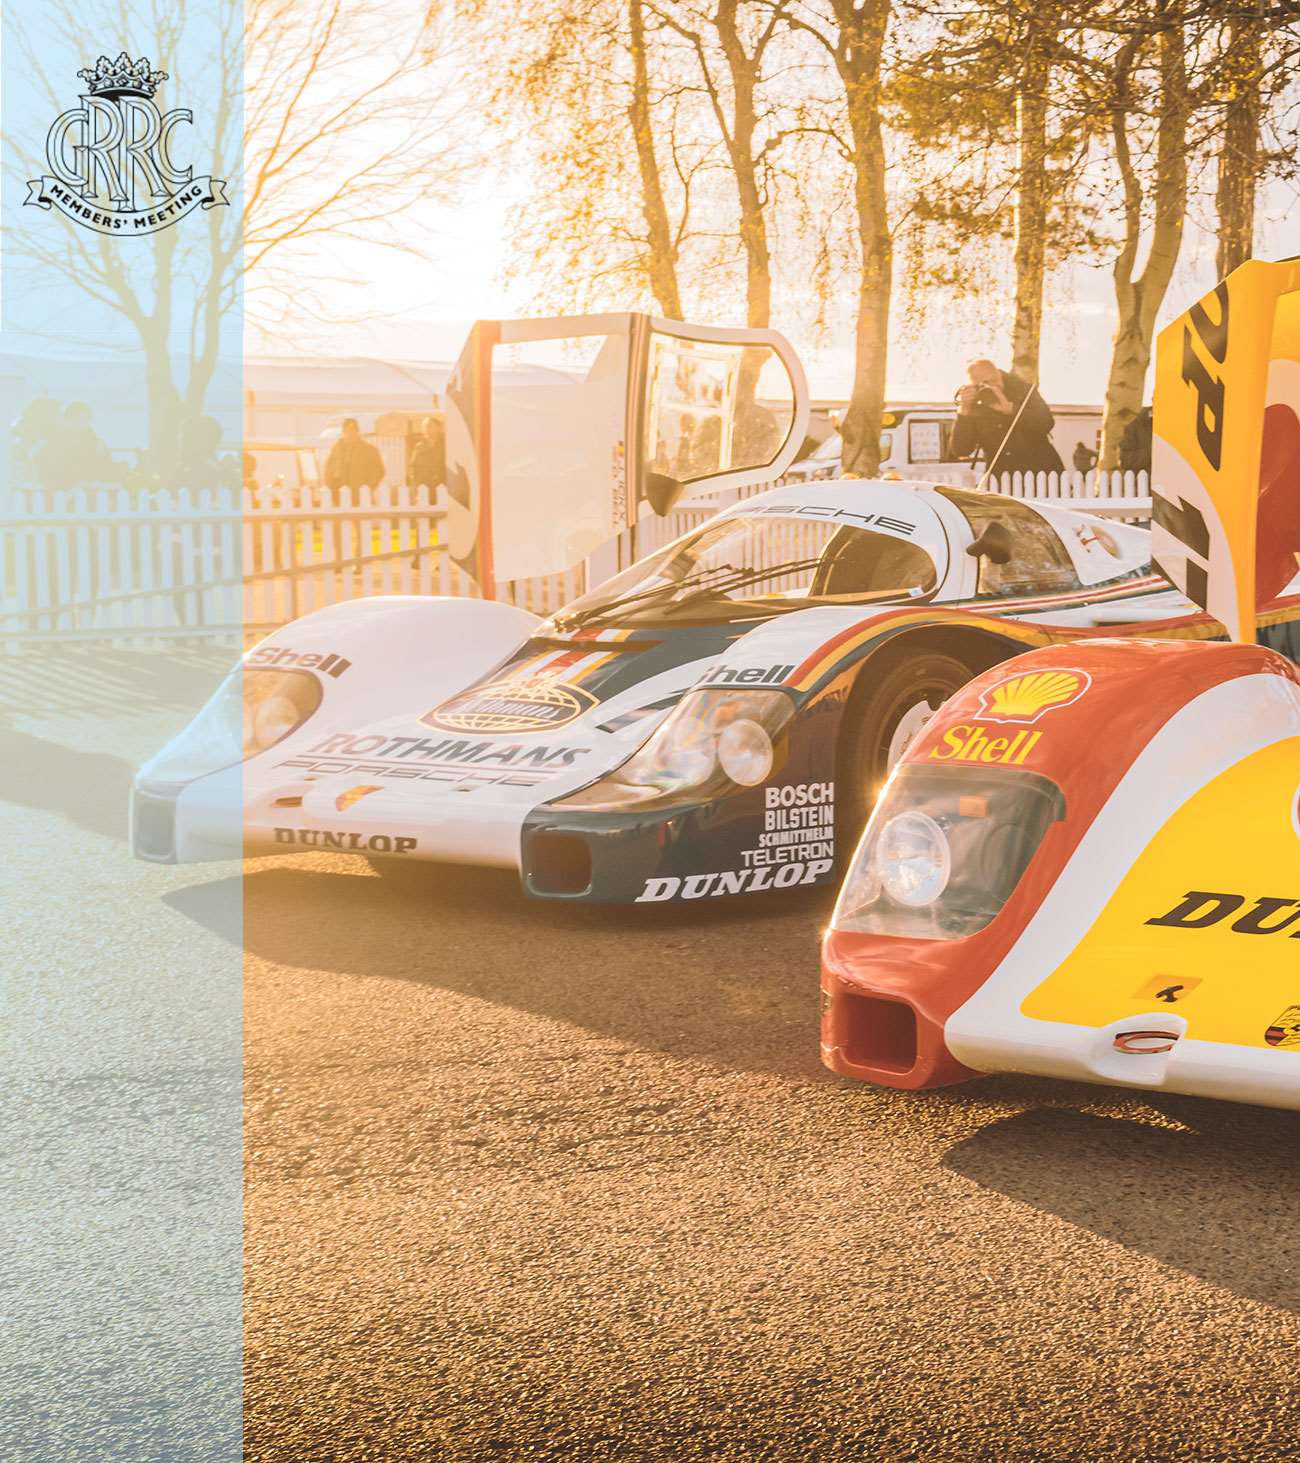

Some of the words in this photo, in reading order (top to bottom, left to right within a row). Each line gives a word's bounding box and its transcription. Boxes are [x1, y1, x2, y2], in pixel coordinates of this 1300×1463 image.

[748, 505, 917, 536] SCHE
[251, 647, 352, 679] Shell
[305, 732, 592, 768] ROTHMANS
[929, 725, 1043, 765] Shell
[272, 759, 545, 787] PORSCHE
[765, 782, 835, 808] BOSCH
[765, 804, 835, 831] BILSTEIN
[273, 827, 418, 853] DUNLOP
[741, 841, 834, 867] TELETRON
[634, 859, 834, 902] DUNLOP
